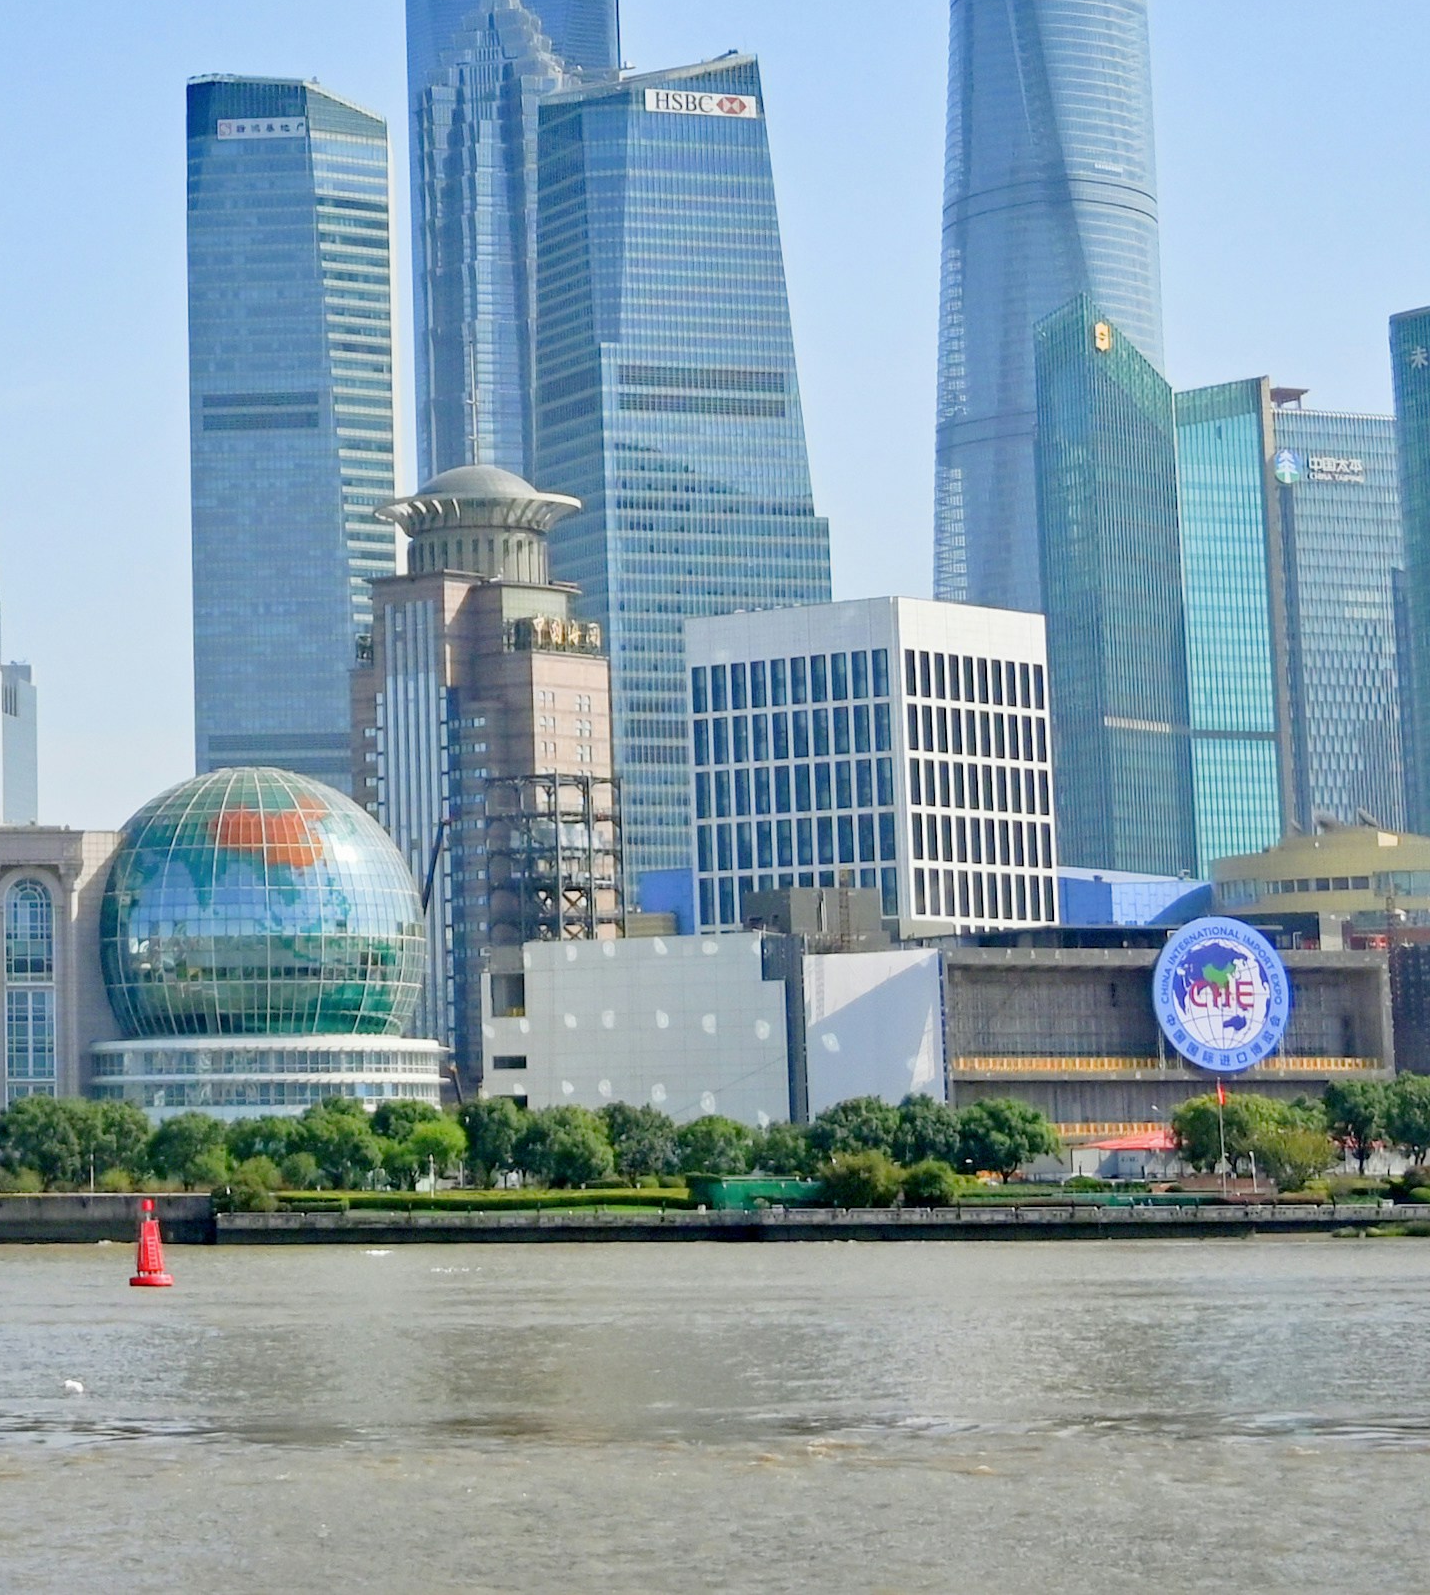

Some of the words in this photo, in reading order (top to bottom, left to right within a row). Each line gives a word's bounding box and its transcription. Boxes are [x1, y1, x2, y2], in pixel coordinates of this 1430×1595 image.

[655, 91, 714, 113] HSBC
[1309, 457, 1363, 472] 中国太平
[1161, 971, 1171, 1004] CHINA
[1167, 926, 1240, 965] INTERNATIONAL
[1243, 934, 1274, 970] IMPORT
[1270, 973, 1282, 1005] EXPO
